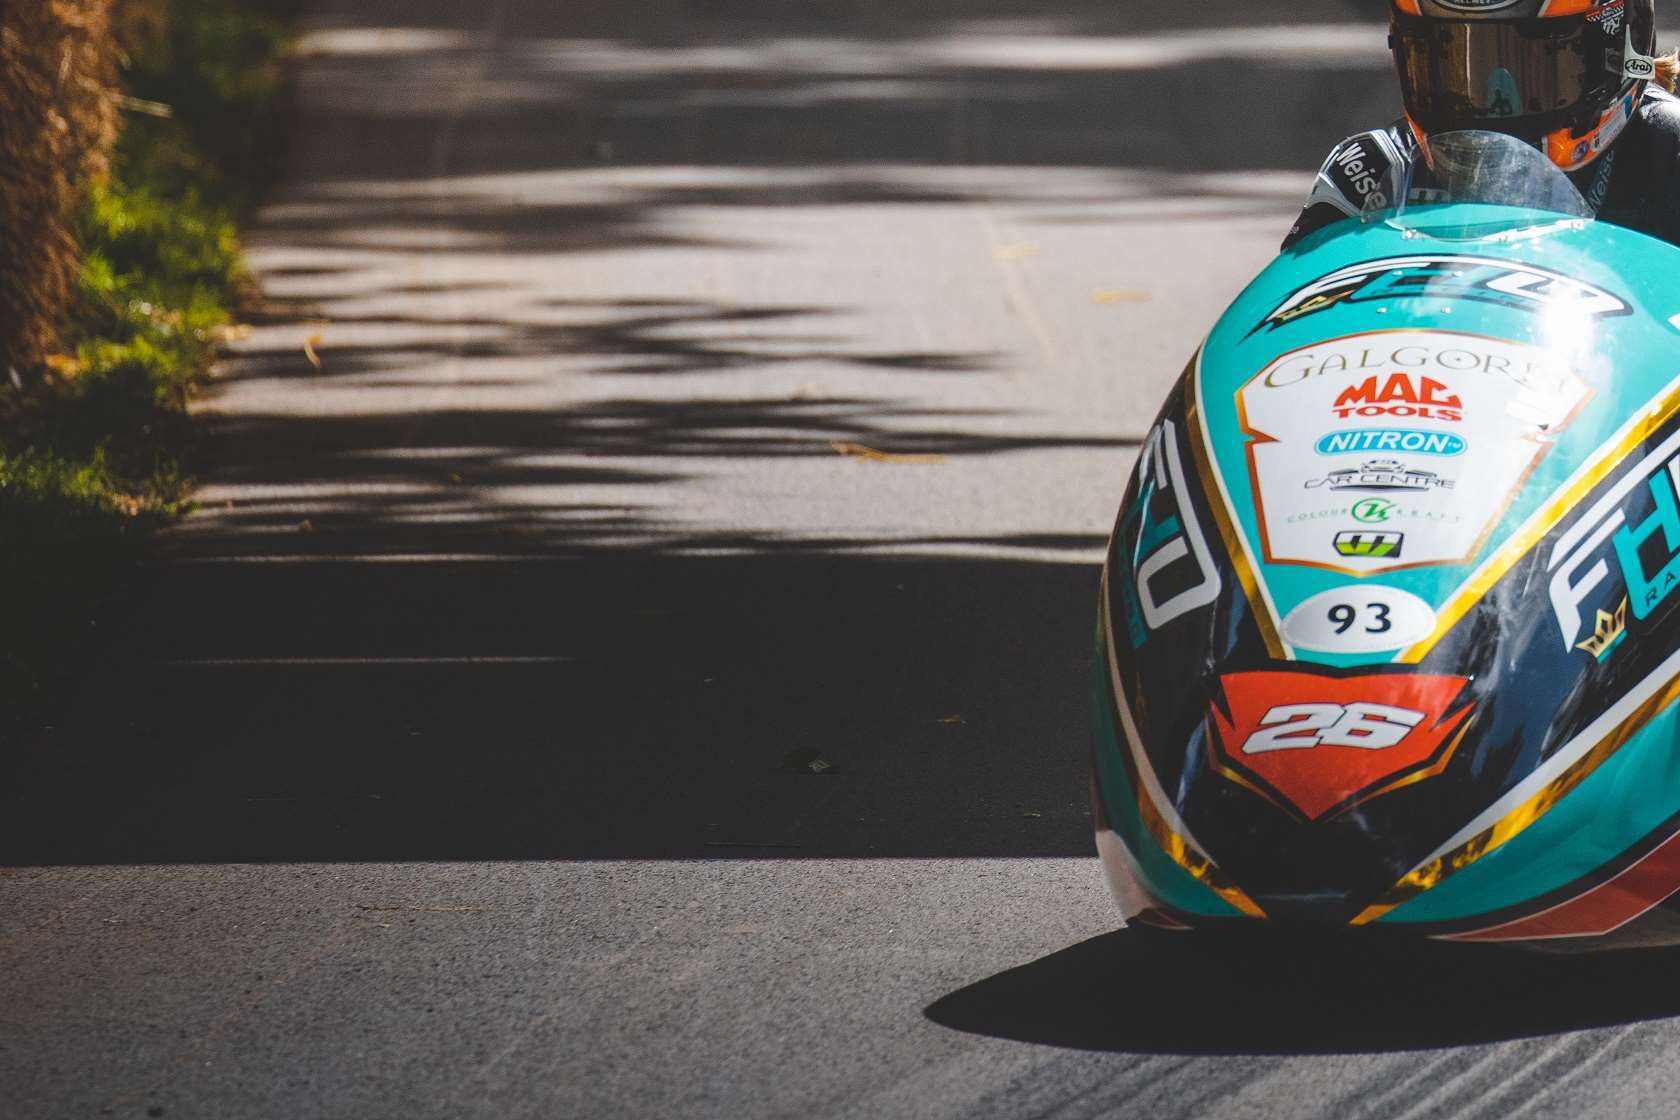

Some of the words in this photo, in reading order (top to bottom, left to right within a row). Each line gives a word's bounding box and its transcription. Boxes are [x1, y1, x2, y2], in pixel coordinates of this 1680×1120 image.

[1625, 59, 1651, 74] Arai
[1336, 142, 1388, 210] Weise
[1333, 373, 1464, 410] MAC
[1332, 406, 1464, 423] TOOLS
[1304, 475, 1353, 490] CAR
[1360, 474, 1457, 491] CENTRE
[1327, 602, 1394, 637] 93
[1242, 700, 1426, 756] 26
